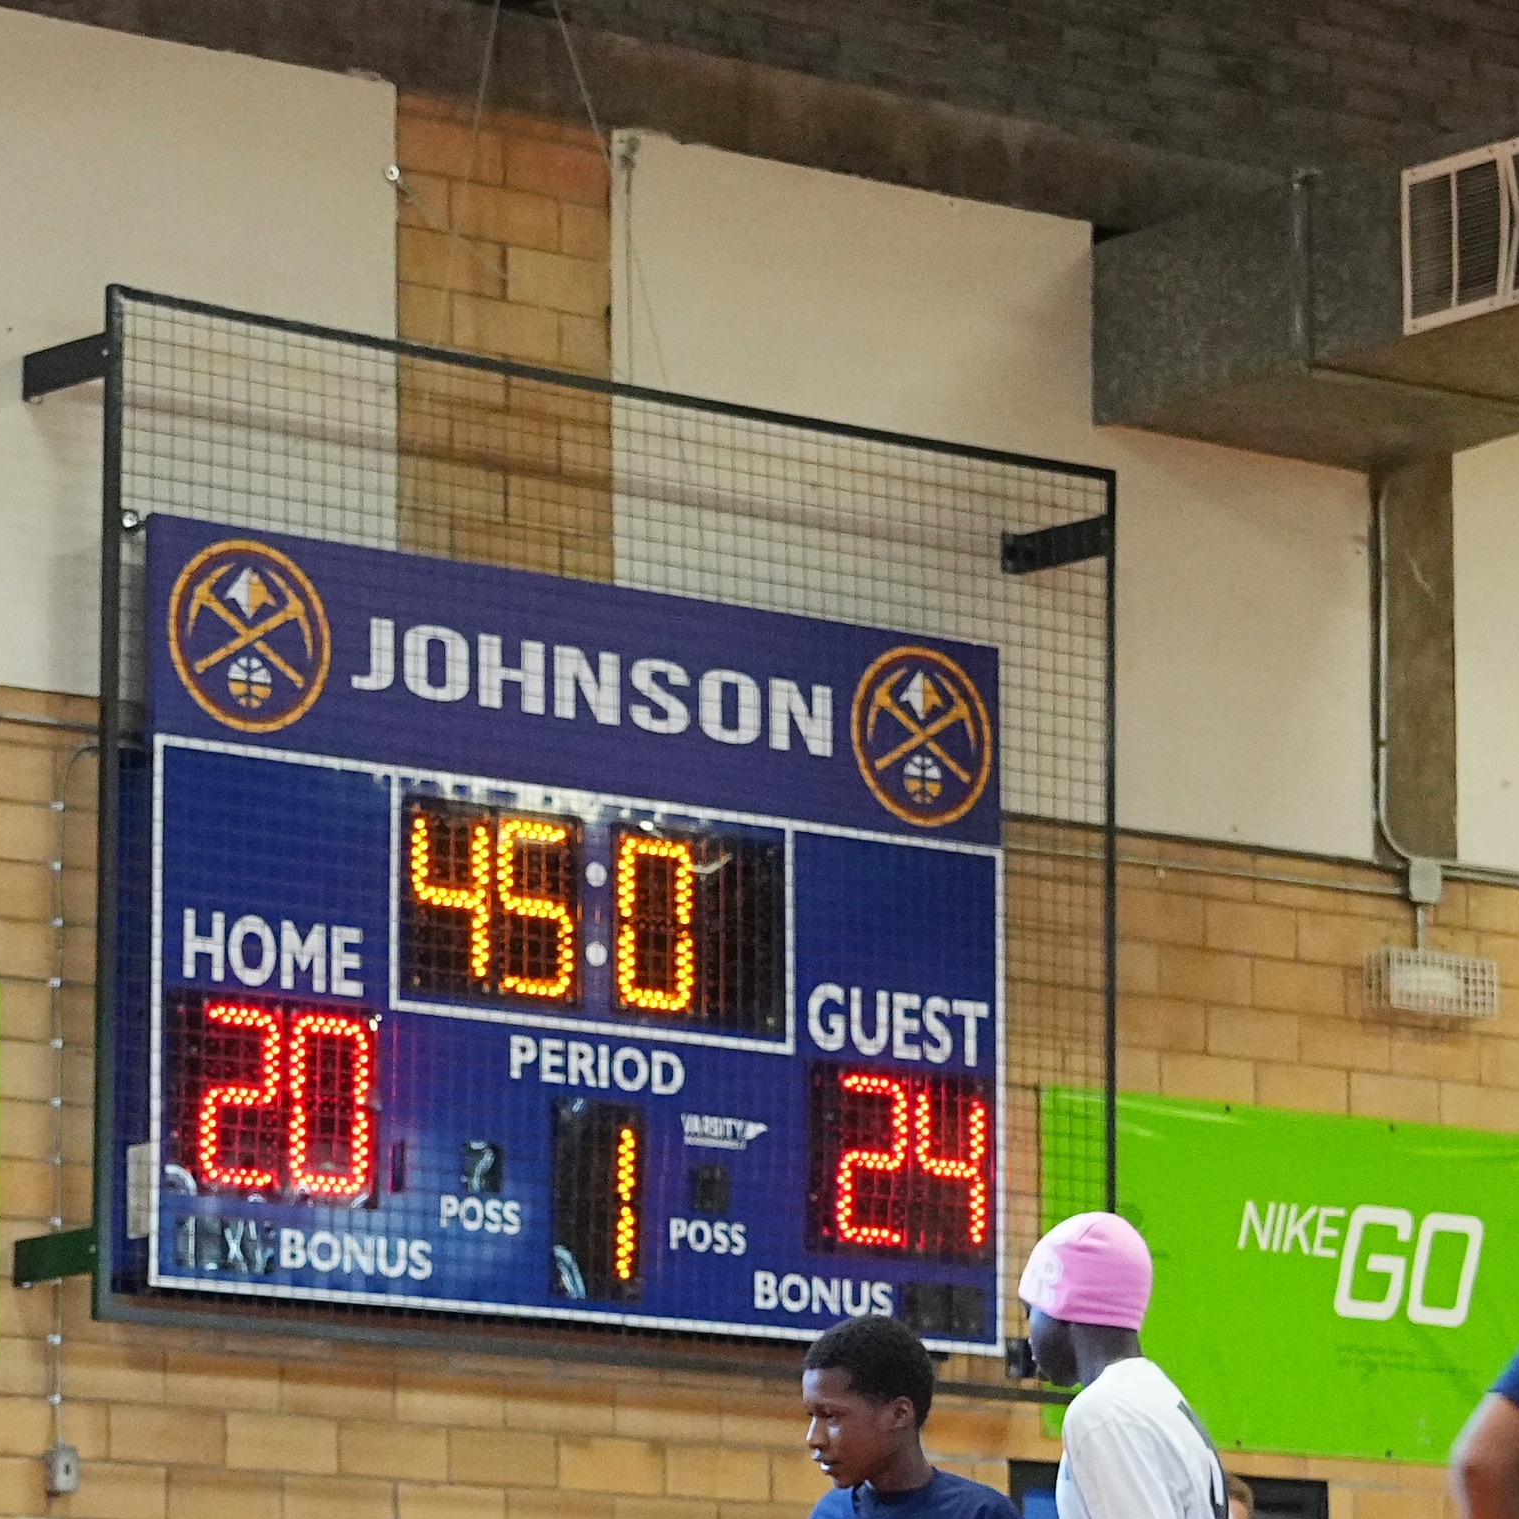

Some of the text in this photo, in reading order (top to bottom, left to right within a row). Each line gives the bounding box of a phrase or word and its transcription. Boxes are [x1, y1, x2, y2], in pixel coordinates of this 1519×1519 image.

[350, 617, 833, 757] JOHNSON
[183, 909, 363, 997] HOME
[509, 1034, 686, 1096] PERIOD
[808, 982, 989, 1067] GUEST
[199, 1004, 370, 1196] 20
[836, 1074, 987, 1245] 24
[280, 1227, 433, 1280] BONUS
[439, 1195, 522, 1235] POSS
[669, 1217, 747, 1256] POSS
[753, 1270, 894, 1319] BONUS
[1237, 1200, 1483, 1329] NIKE GO
